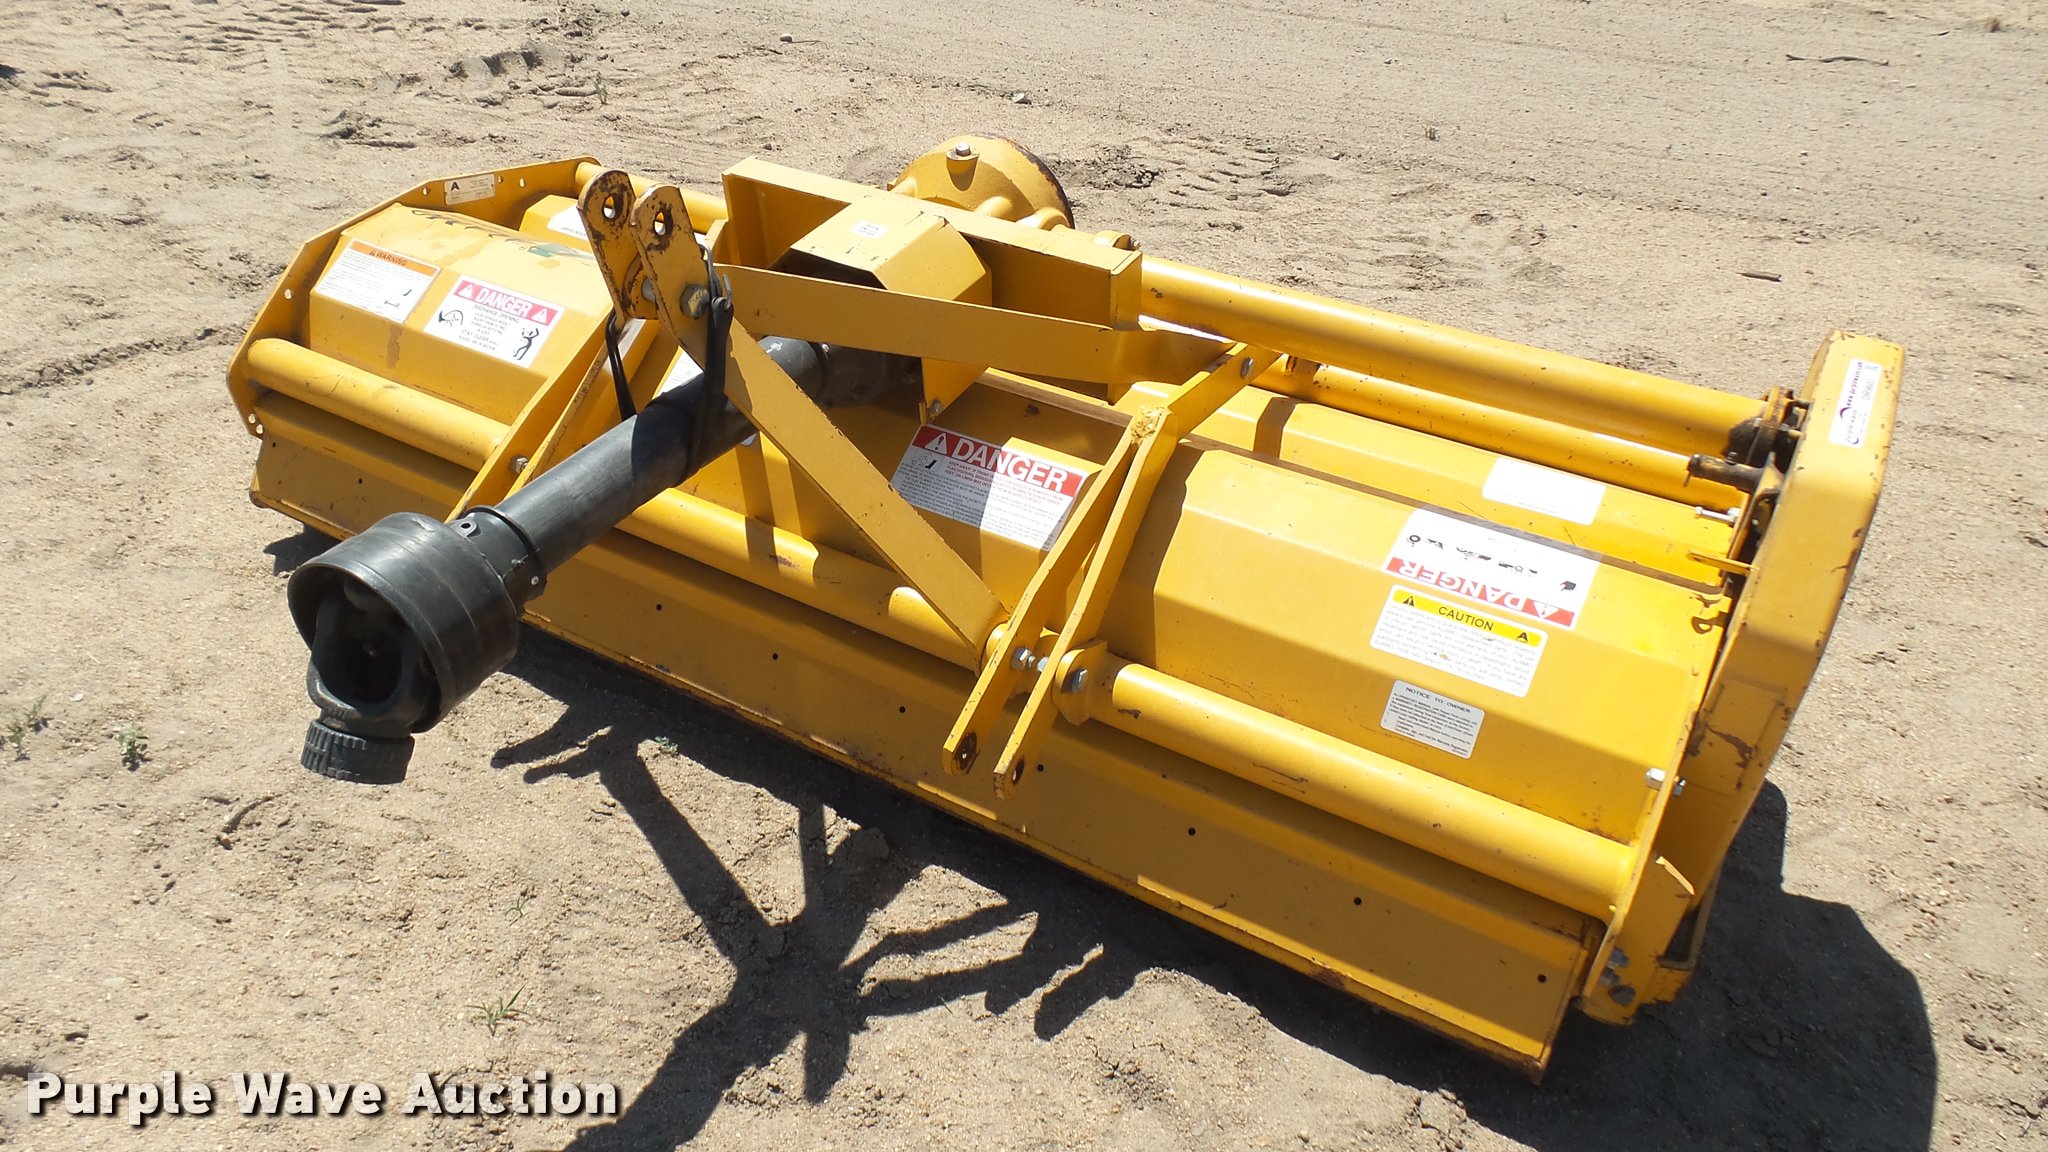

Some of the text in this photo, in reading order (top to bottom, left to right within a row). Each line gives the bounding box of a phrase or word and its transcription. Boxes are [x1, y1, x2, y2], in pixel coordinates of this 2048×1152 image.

[376, 252, 407, 267] WARNING
[475, 287, 533, 318] DANGER
[951, 437, 1068, 493] DANGER
[1398, 559, 1528, 612] DANGER
[1438, 606, 1495, 631] CAUTION
[1405, 686, 1430, 700] NOTICE
[1446, 701, 1471, 714] OWNER
